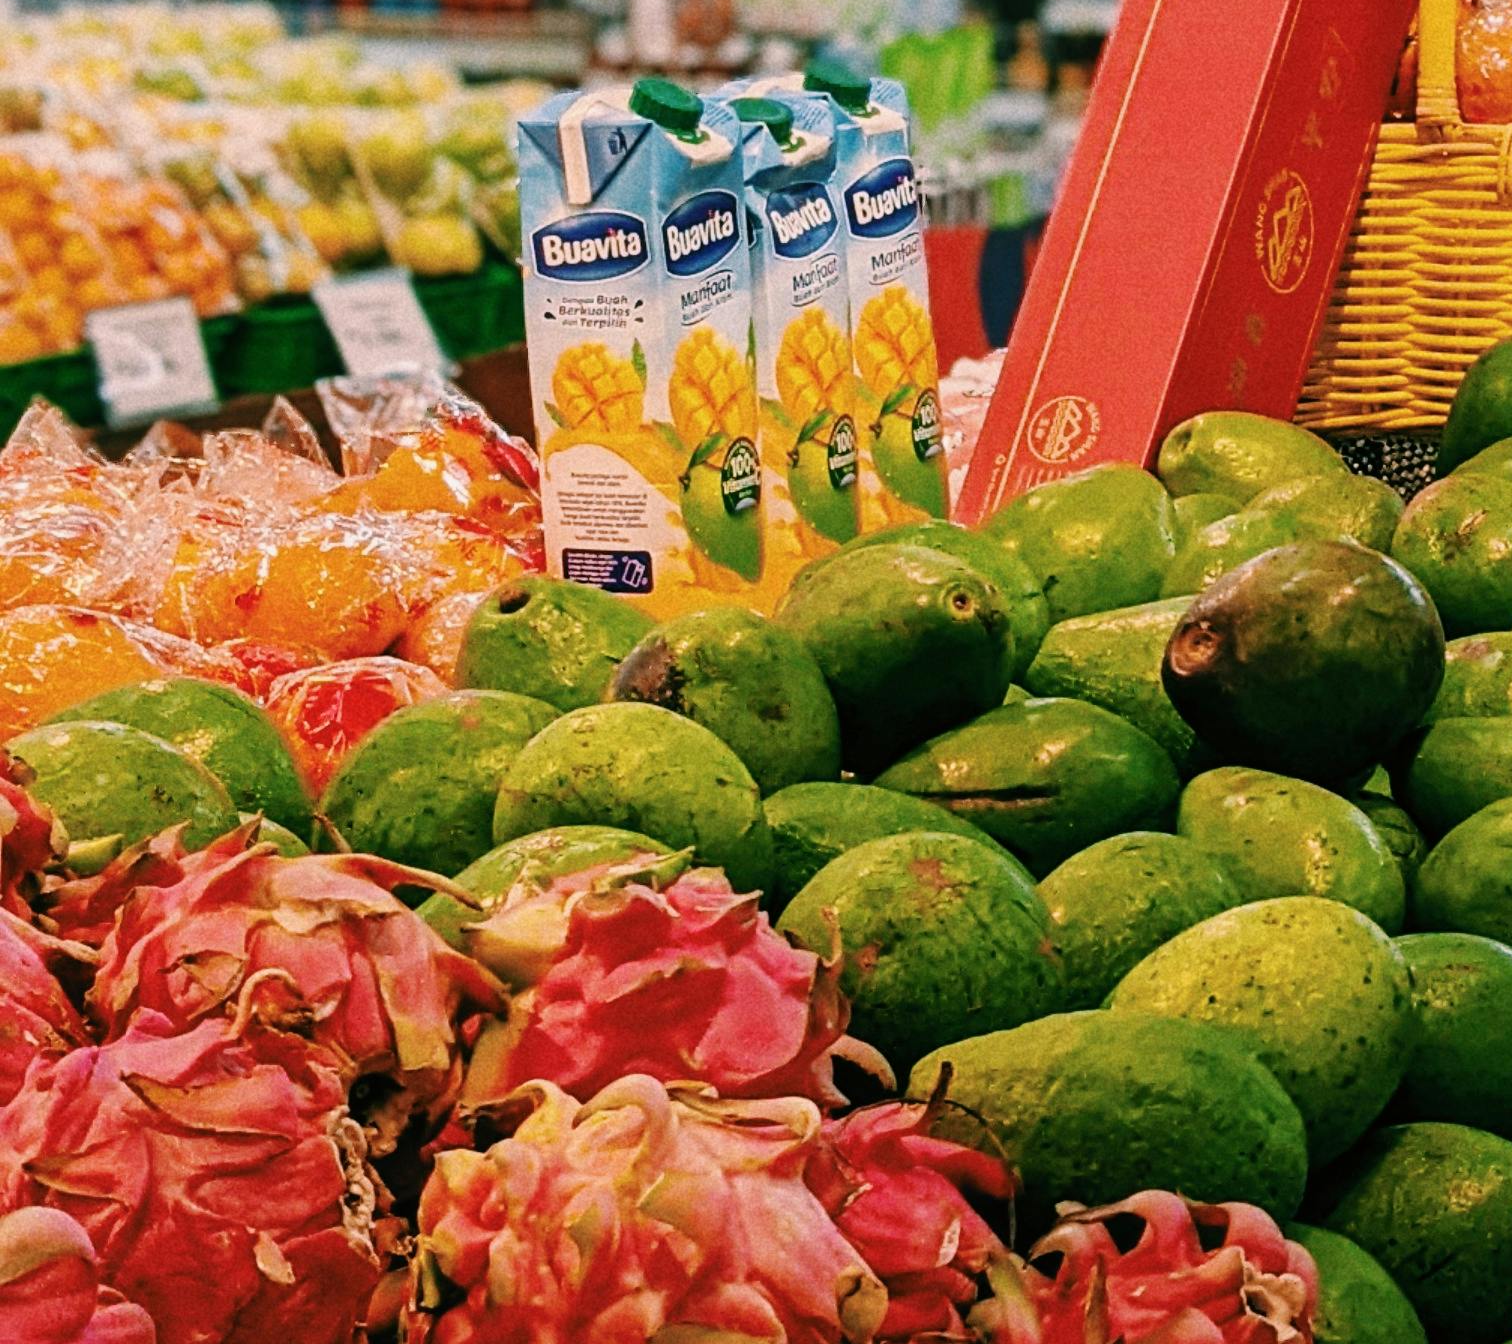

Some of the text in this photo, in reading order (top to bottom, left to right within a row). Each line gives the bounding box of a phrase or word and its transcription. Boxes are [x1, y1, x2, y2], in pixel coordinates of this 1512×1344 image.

[541, 228, 642, 267] Buavita
[667, 210, 734, 261] Buavita
[681, 274, 731, 309] Manfaat
